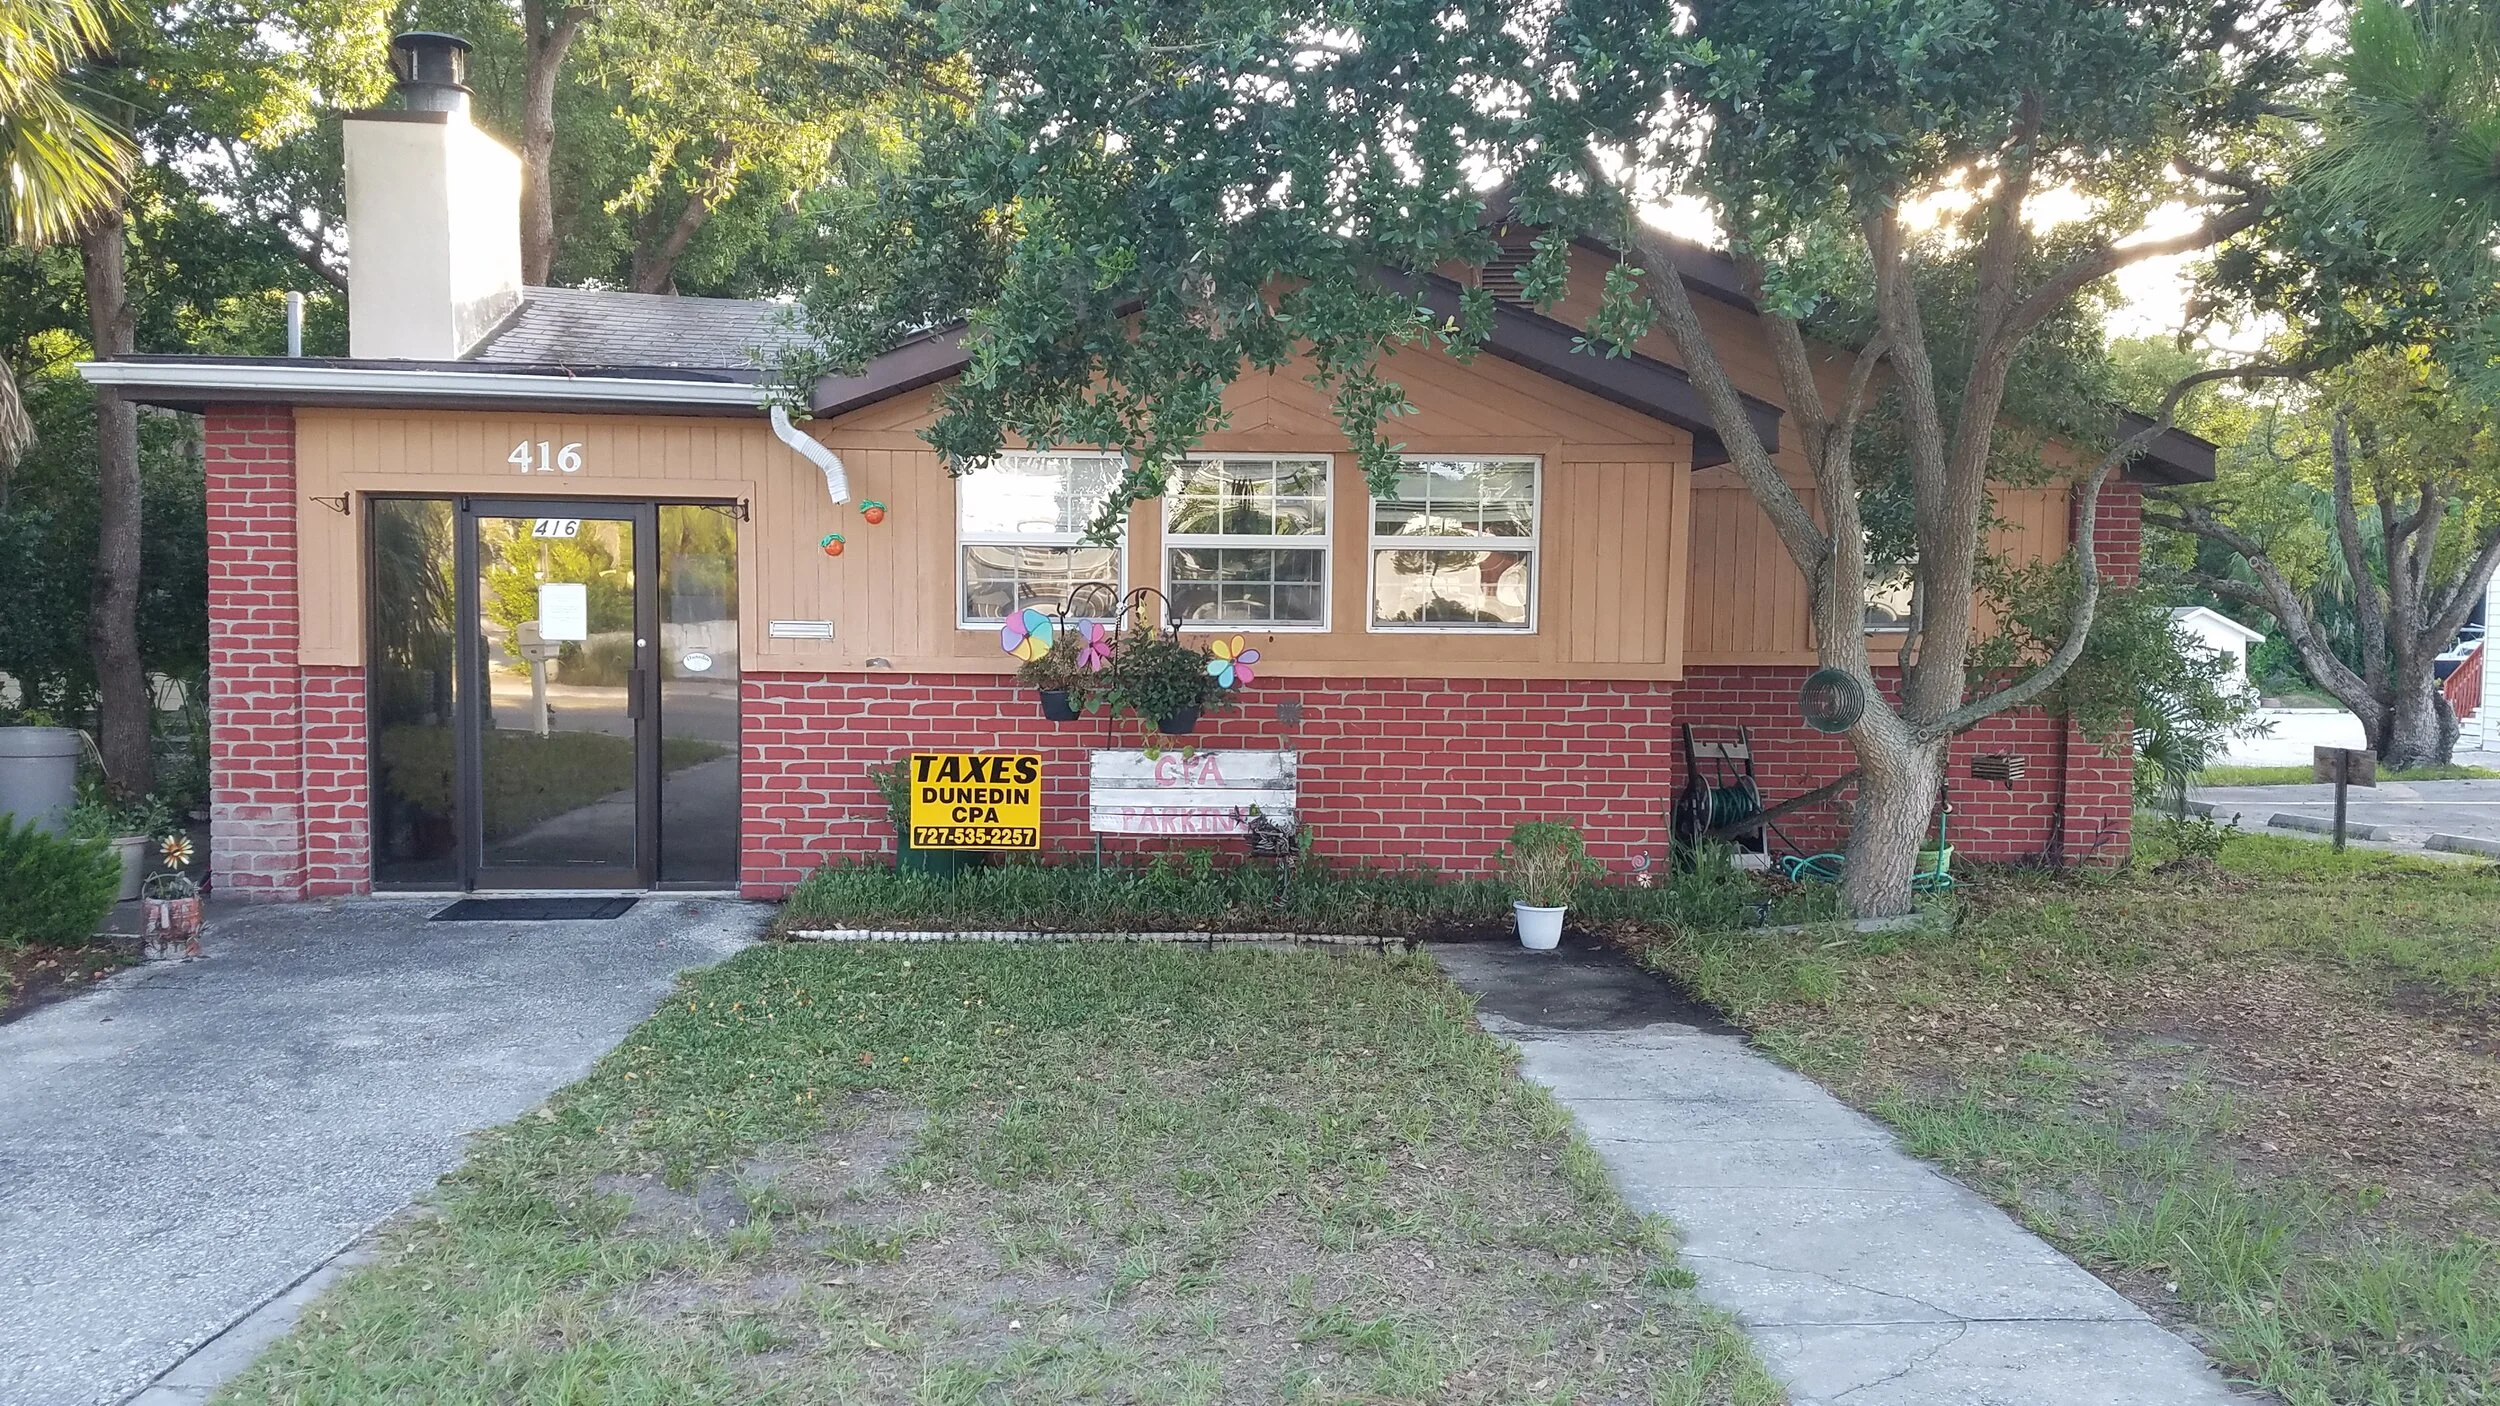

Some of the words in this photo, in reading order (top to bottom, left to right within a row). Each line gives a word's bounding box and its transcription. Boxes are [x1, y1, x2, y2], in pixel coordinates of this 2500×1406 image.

[507, 440, 583, 473] 416
[534, 519, 577, 536] 416
[913, 756, 1039, 784] TAXES
[1154, 754, 1226, 787] CPA
[922, 787, 1029, 804] DUNEDIN
[951, 807, 999, 823] CPA
[917, 828, 1034, 845] 727-535-2257
